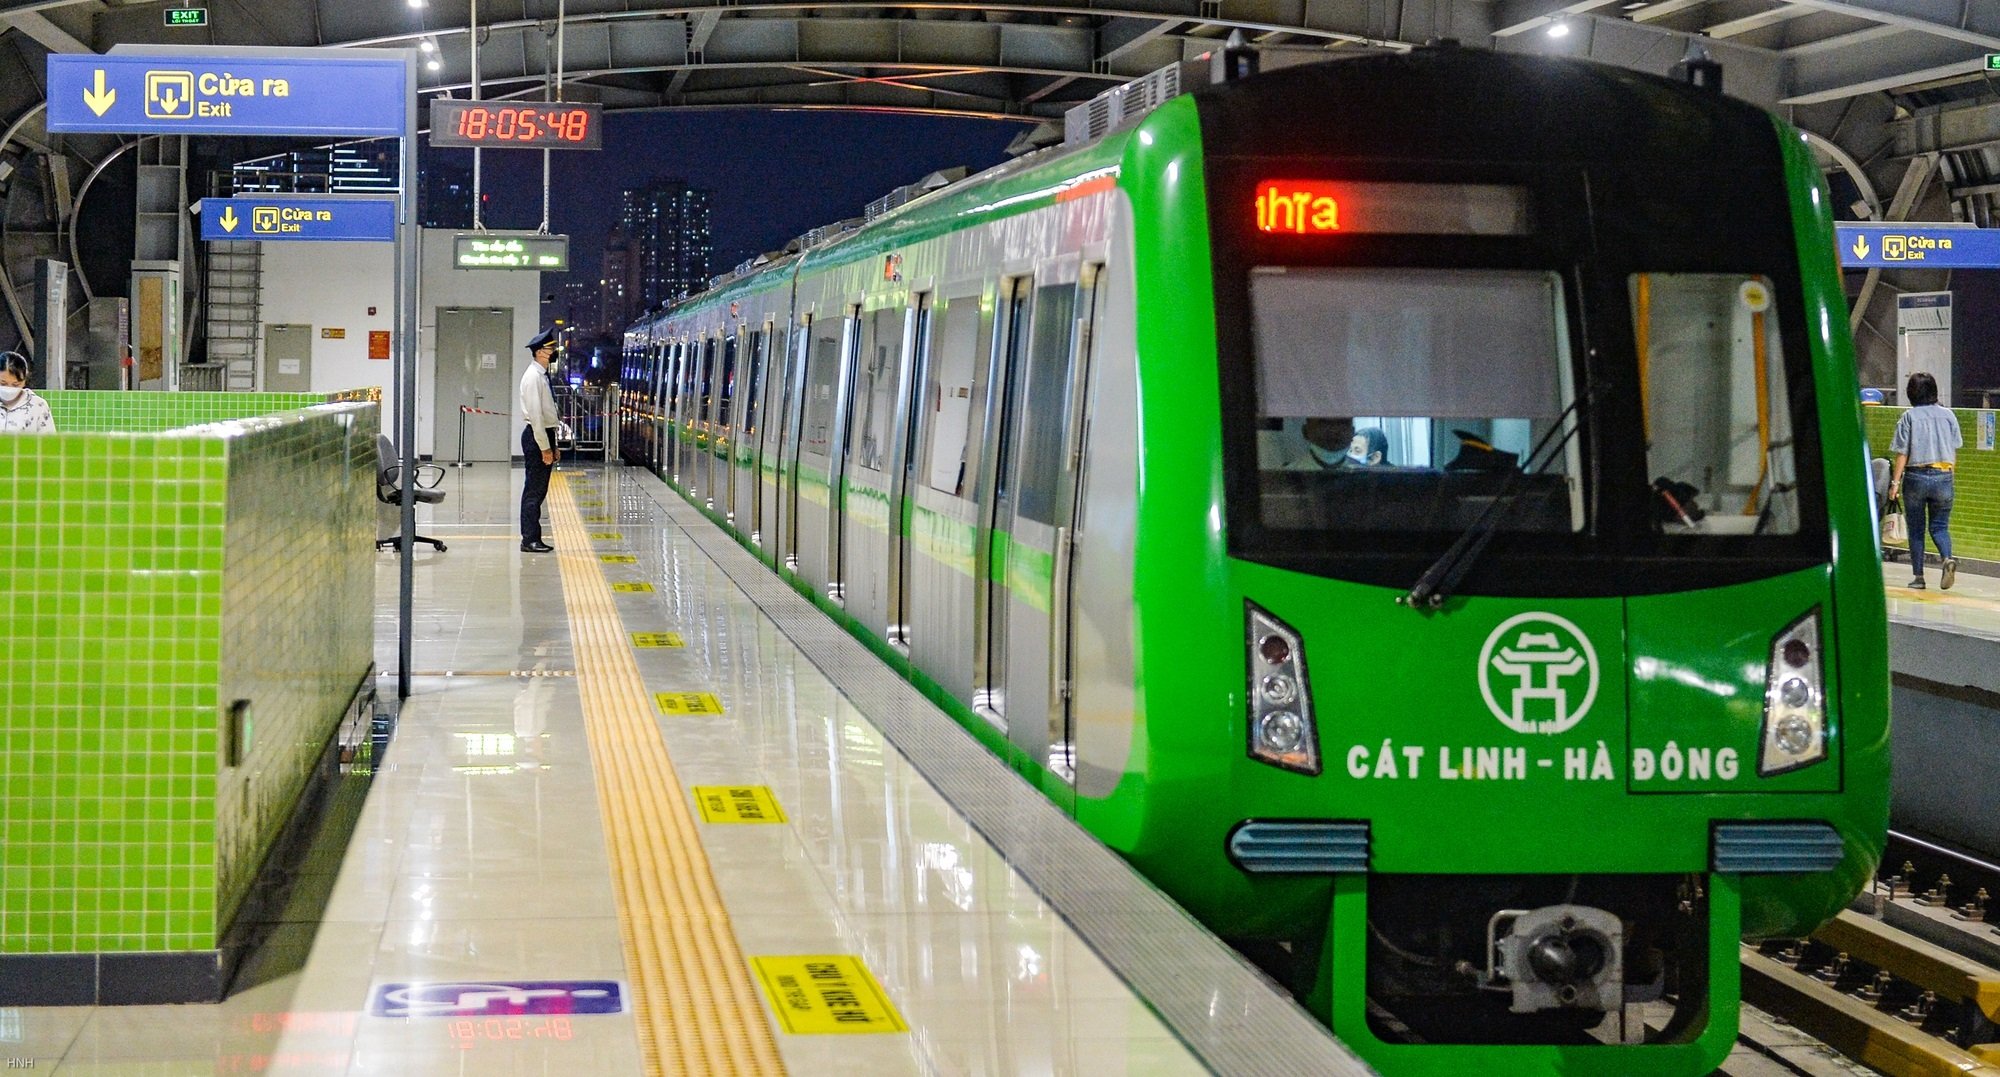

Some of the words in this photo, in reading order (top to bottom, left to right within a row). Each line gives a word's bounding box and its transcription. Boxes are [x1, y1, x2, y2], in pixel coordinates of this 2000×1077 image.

[172, 11, 199, 19] EXIT
[198, 72, 255, 96] Cửa
[262, 79, 289, 96] ra
[198, 101, 232, 117] Exit
[458, 108, 587, 141] 18:05:48
[282, 207, 312, 220] Cửa
[316, 210, 331, 220] ra
[281, 223, 300, 232] Exit
[1938, 239, 1952, 248] ra
[1908, 251, 1924, 259] Exit
[1347, 738, 1424, 780] CÁT
[1439, 746, 1527, 780] LINH
[1564, 739, 1615, 781] HÀ
[1632, 740, 1740, 781] ĐÔNG
